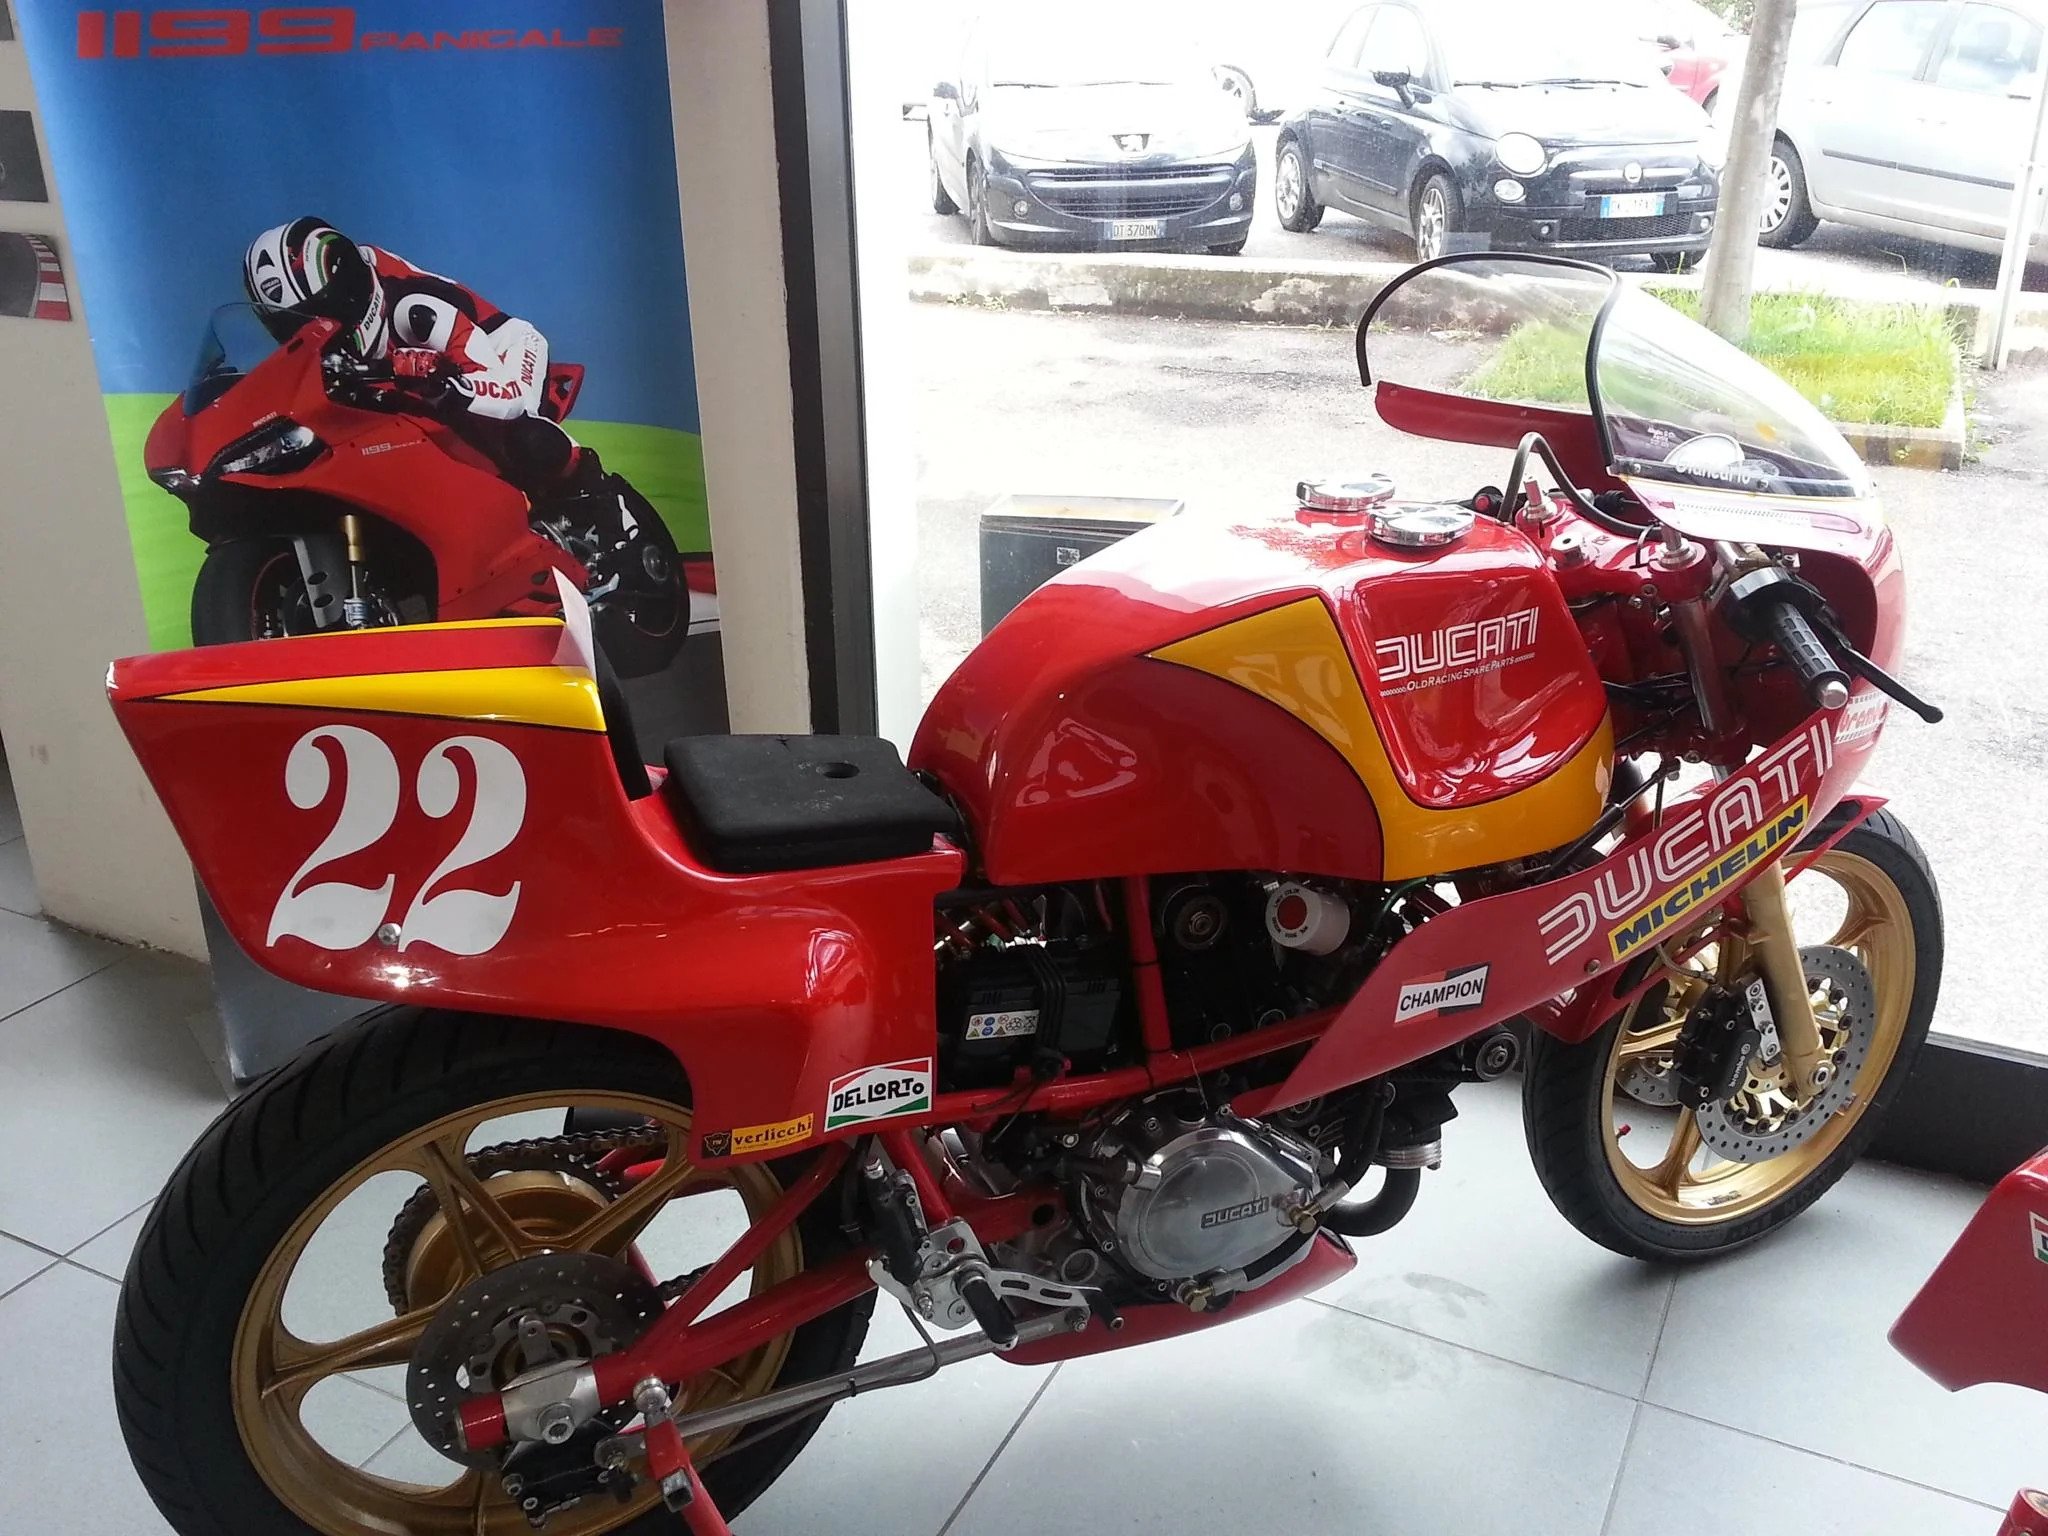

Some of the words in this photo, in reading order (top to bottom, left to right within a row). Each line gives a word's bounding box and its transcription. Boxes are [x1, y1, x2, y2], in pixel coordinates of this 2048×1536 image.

[77, 8, 356, 59] 1199
[363, 293, 382, 331] DUCATI
[473, 380, 522, 400] UCATI
[1375, 606, 1539, 682] DUCATI
[266, 724, 527, 956] 22
[1537, 718, 1832, 966] DUCATI
[1613, 804, 1804, 955] MICHELIN
[1400, 978, 1483, 1011] CHAMPION
[734, 1115, 812, 1145] verlicchi
[1204, 1199, 1267, 1228] DUCATI
